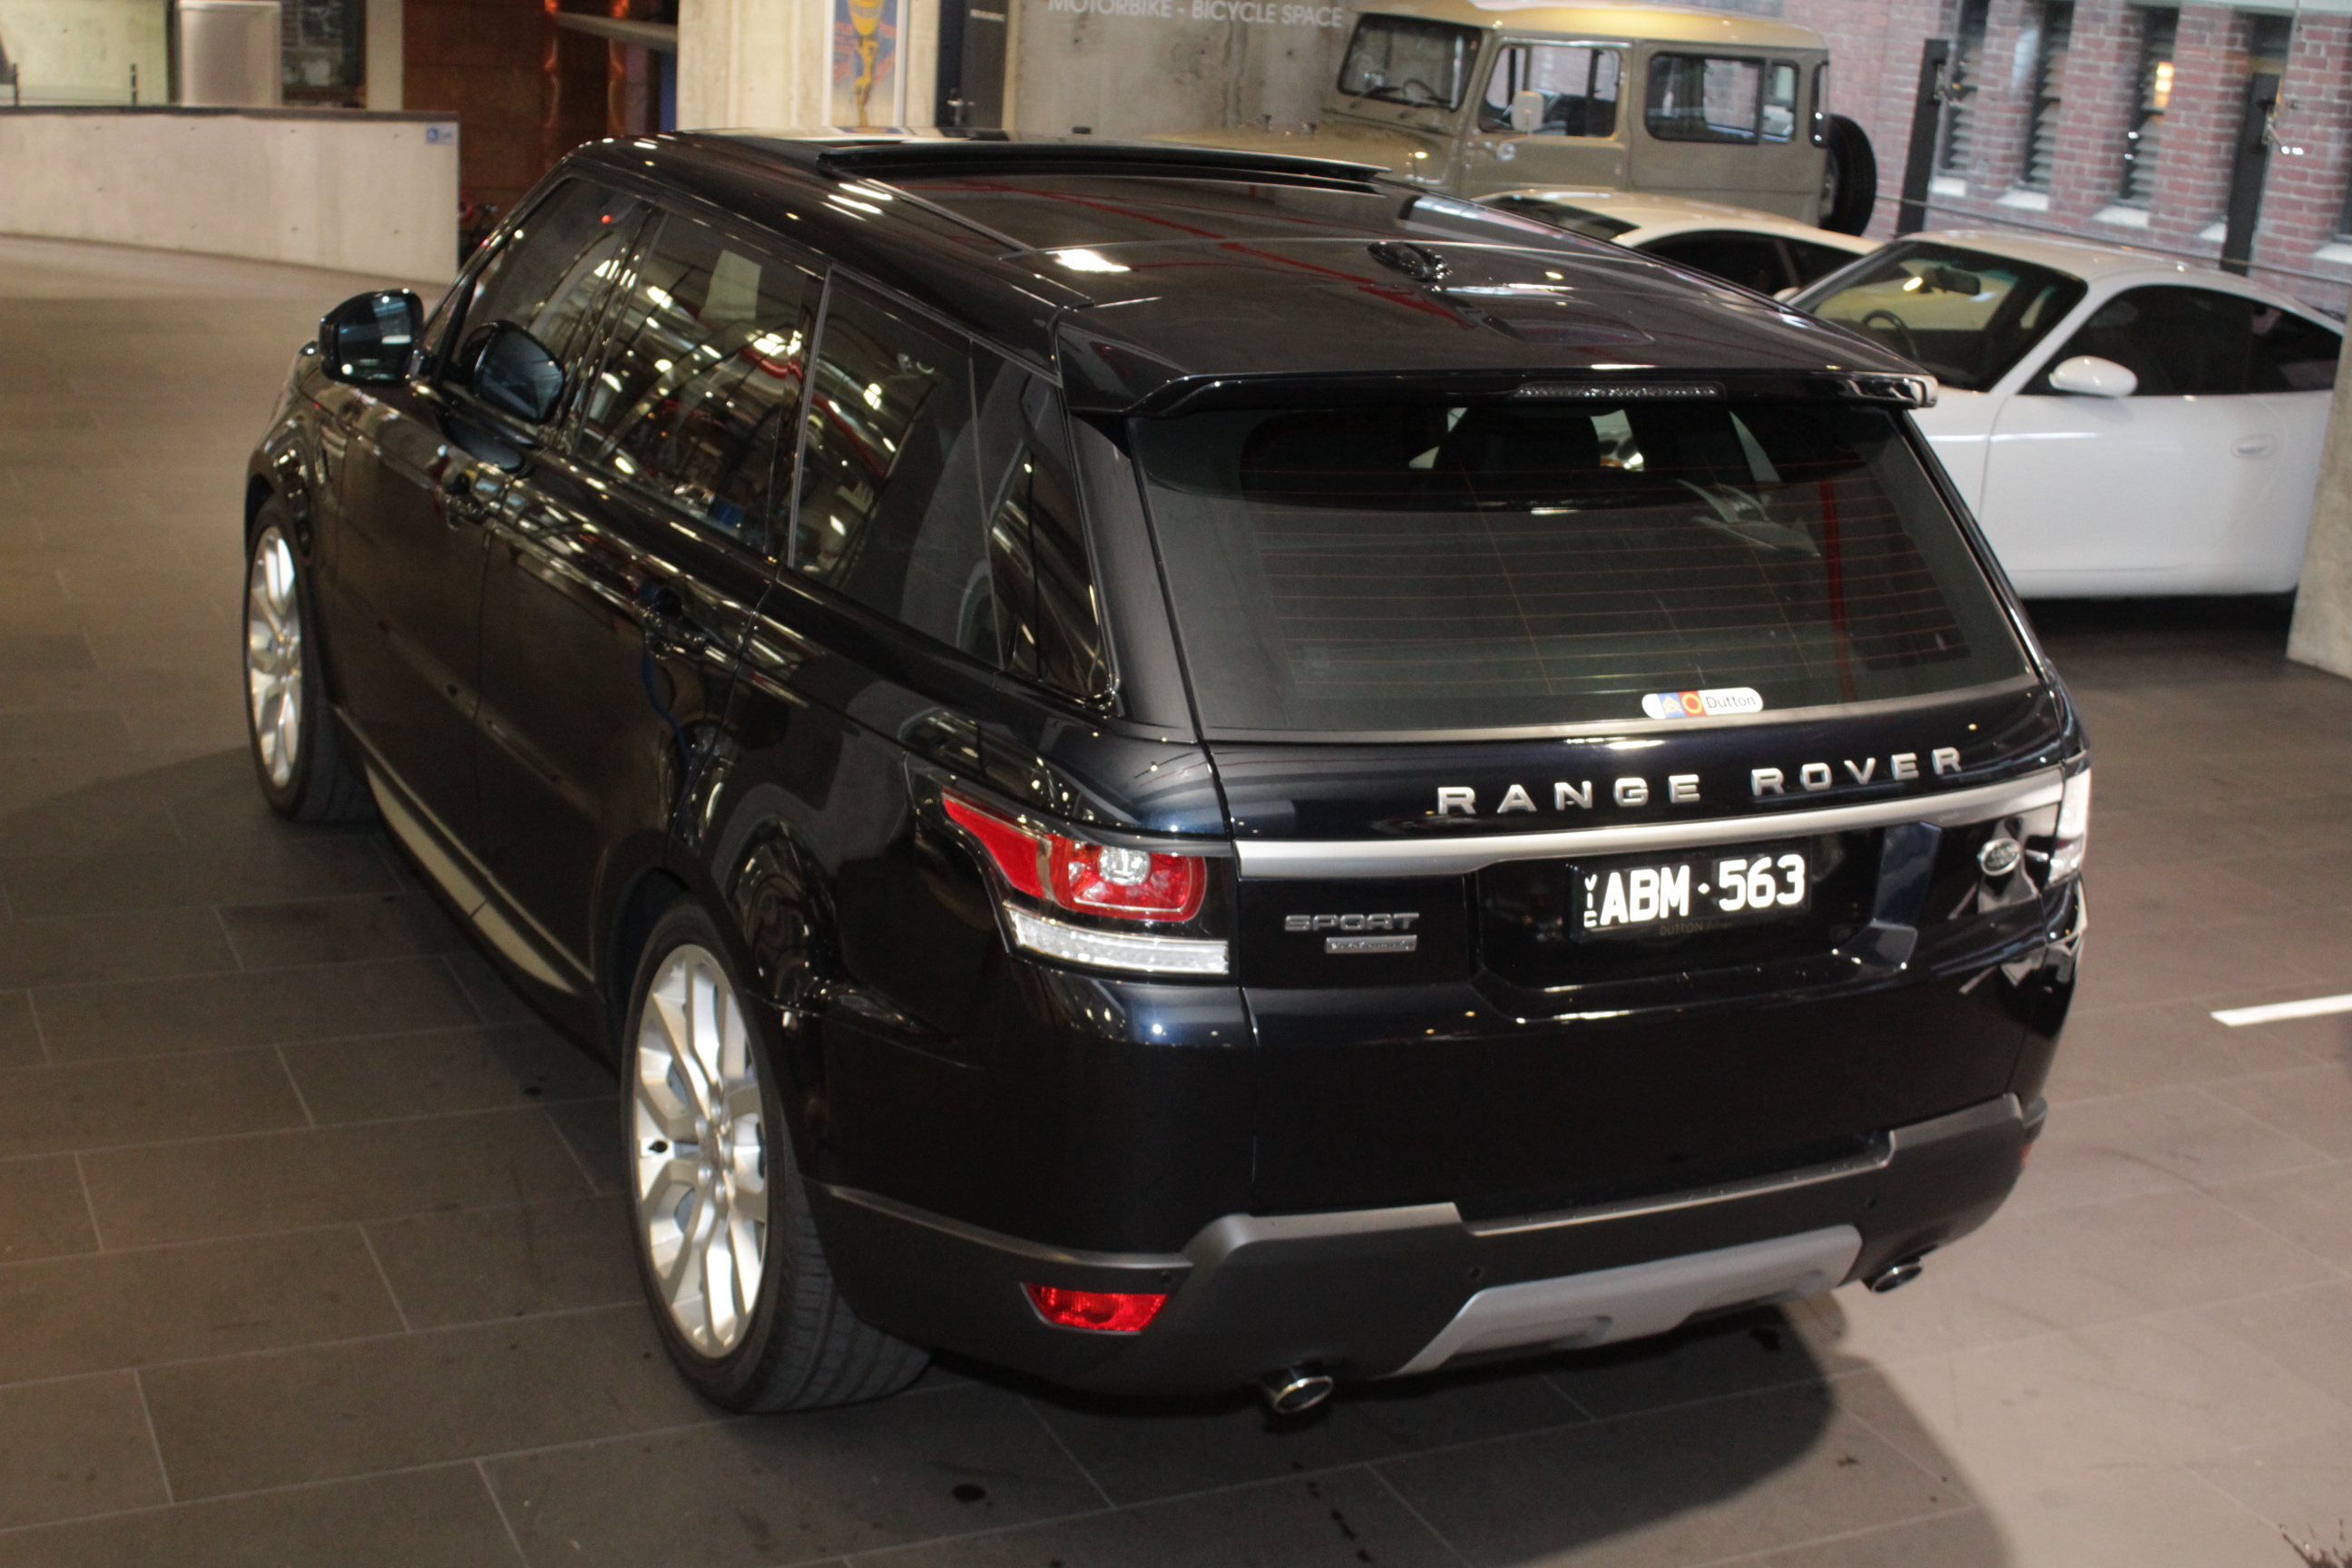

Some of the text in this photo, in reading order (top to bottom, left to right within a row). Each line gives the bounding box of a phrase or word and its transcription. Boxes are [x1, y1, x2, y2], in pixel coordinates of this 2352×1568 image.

[1048, 0, 1172, 18] MOTORBIKE
[1191, 0, 1278, 24] BICYCLE
[1280, 4, 1344, 28] SPACE
[1705, 695, 1757, 709] Dutton
[1436, 747, 1963, 815] RANGE ROVER
[1284, 912, 1420, 931] SPORT
